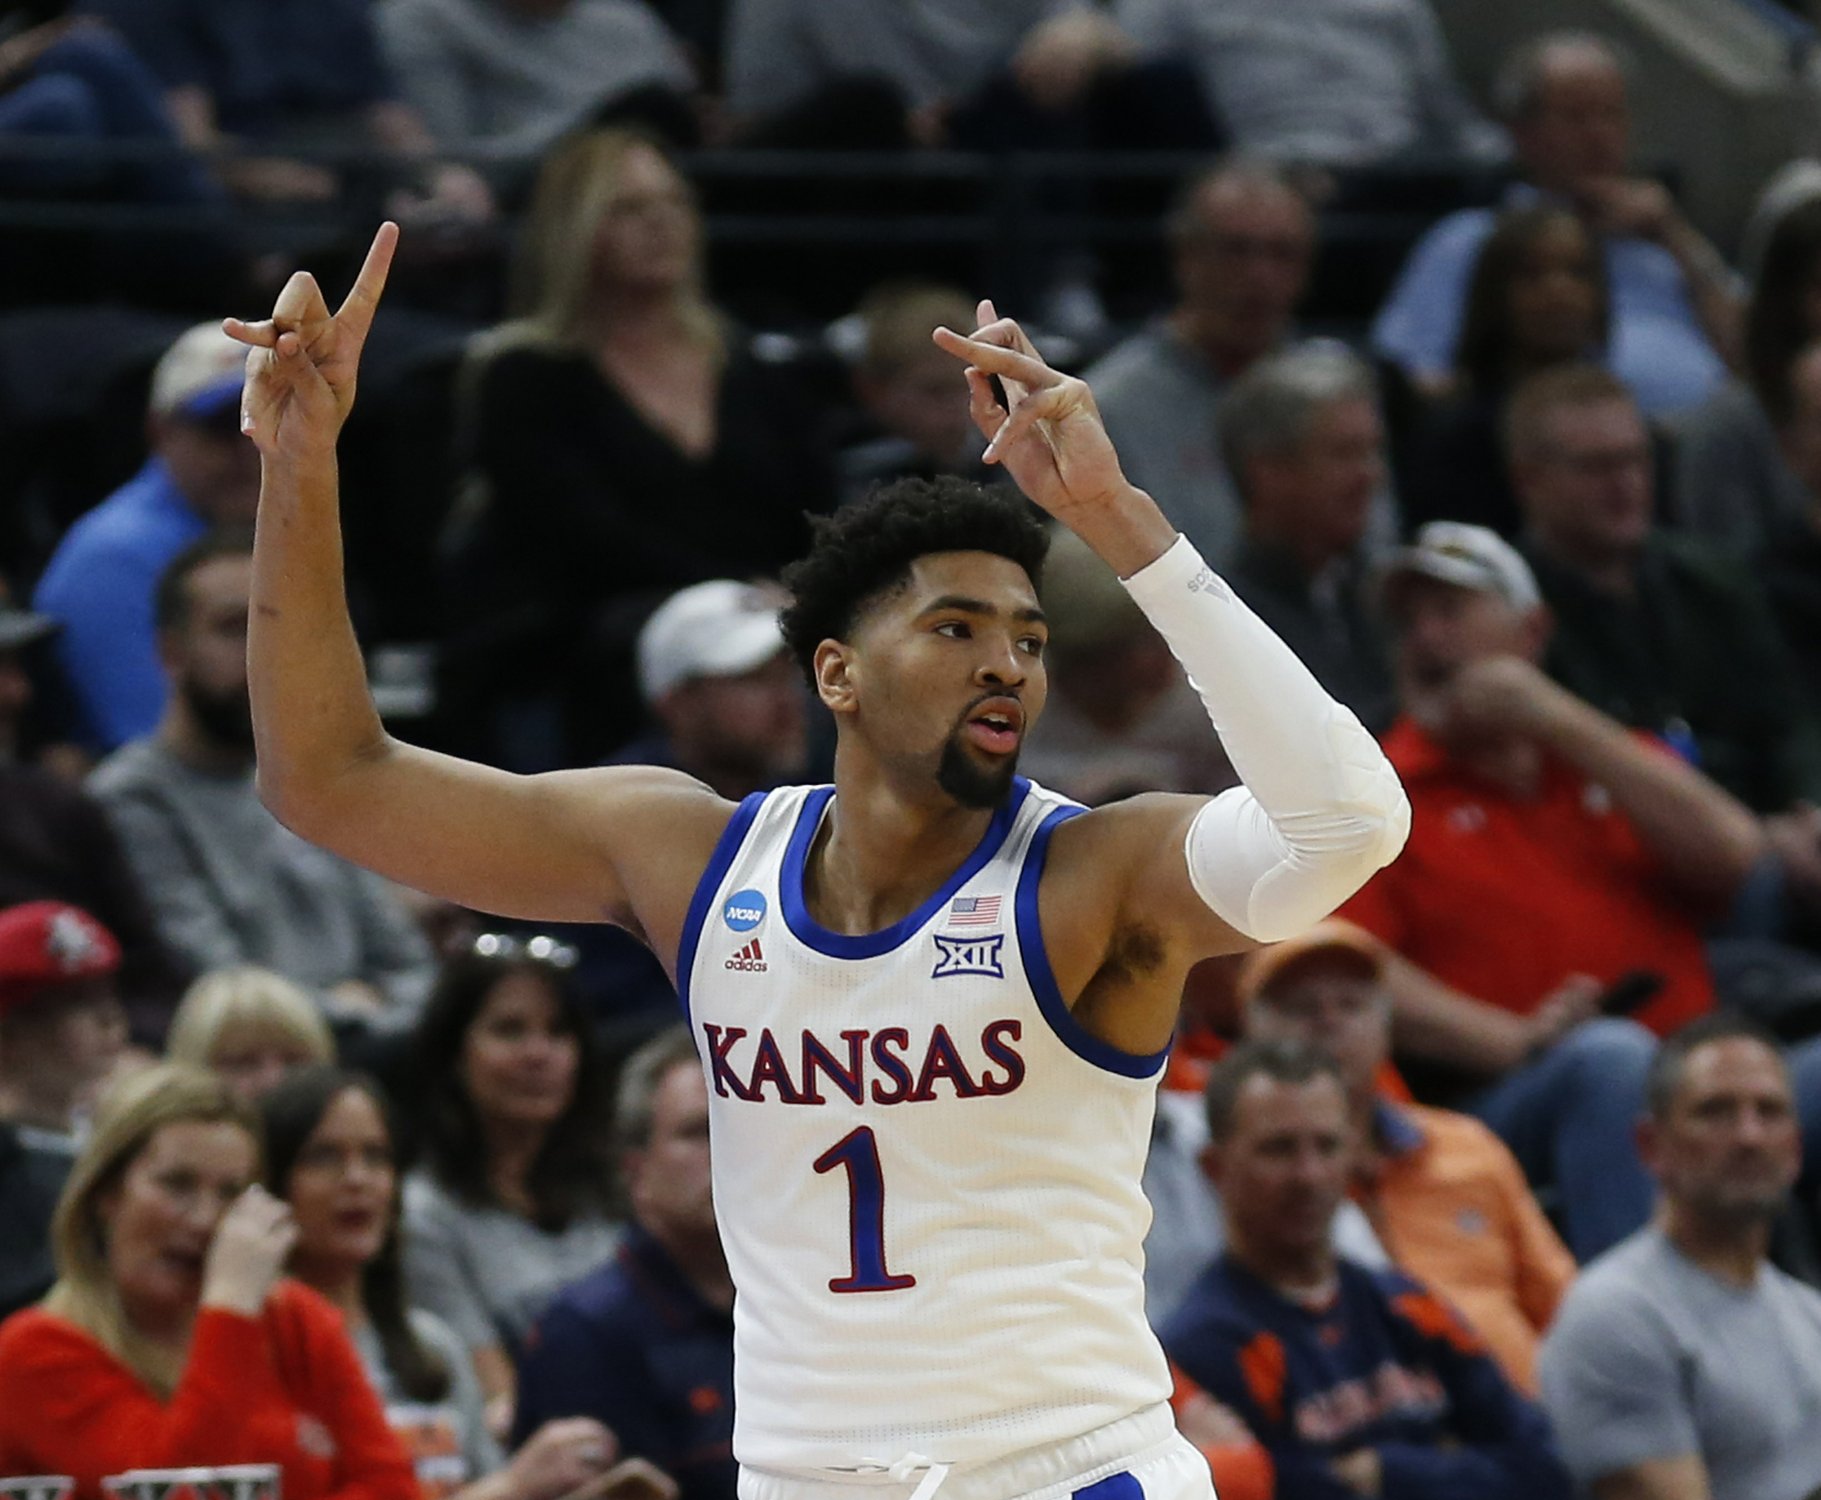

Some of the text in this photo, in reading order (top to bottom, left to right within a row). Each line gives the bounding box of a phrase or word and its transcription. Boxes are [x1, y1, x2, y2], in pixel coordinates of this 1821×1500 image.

[727, 906, 762, 922] NCAA
[724, 957, 768, 972] adidas
[702, 1019, 1026, 1105] KANSAS
[813, 1125, 916, 1293] 1
